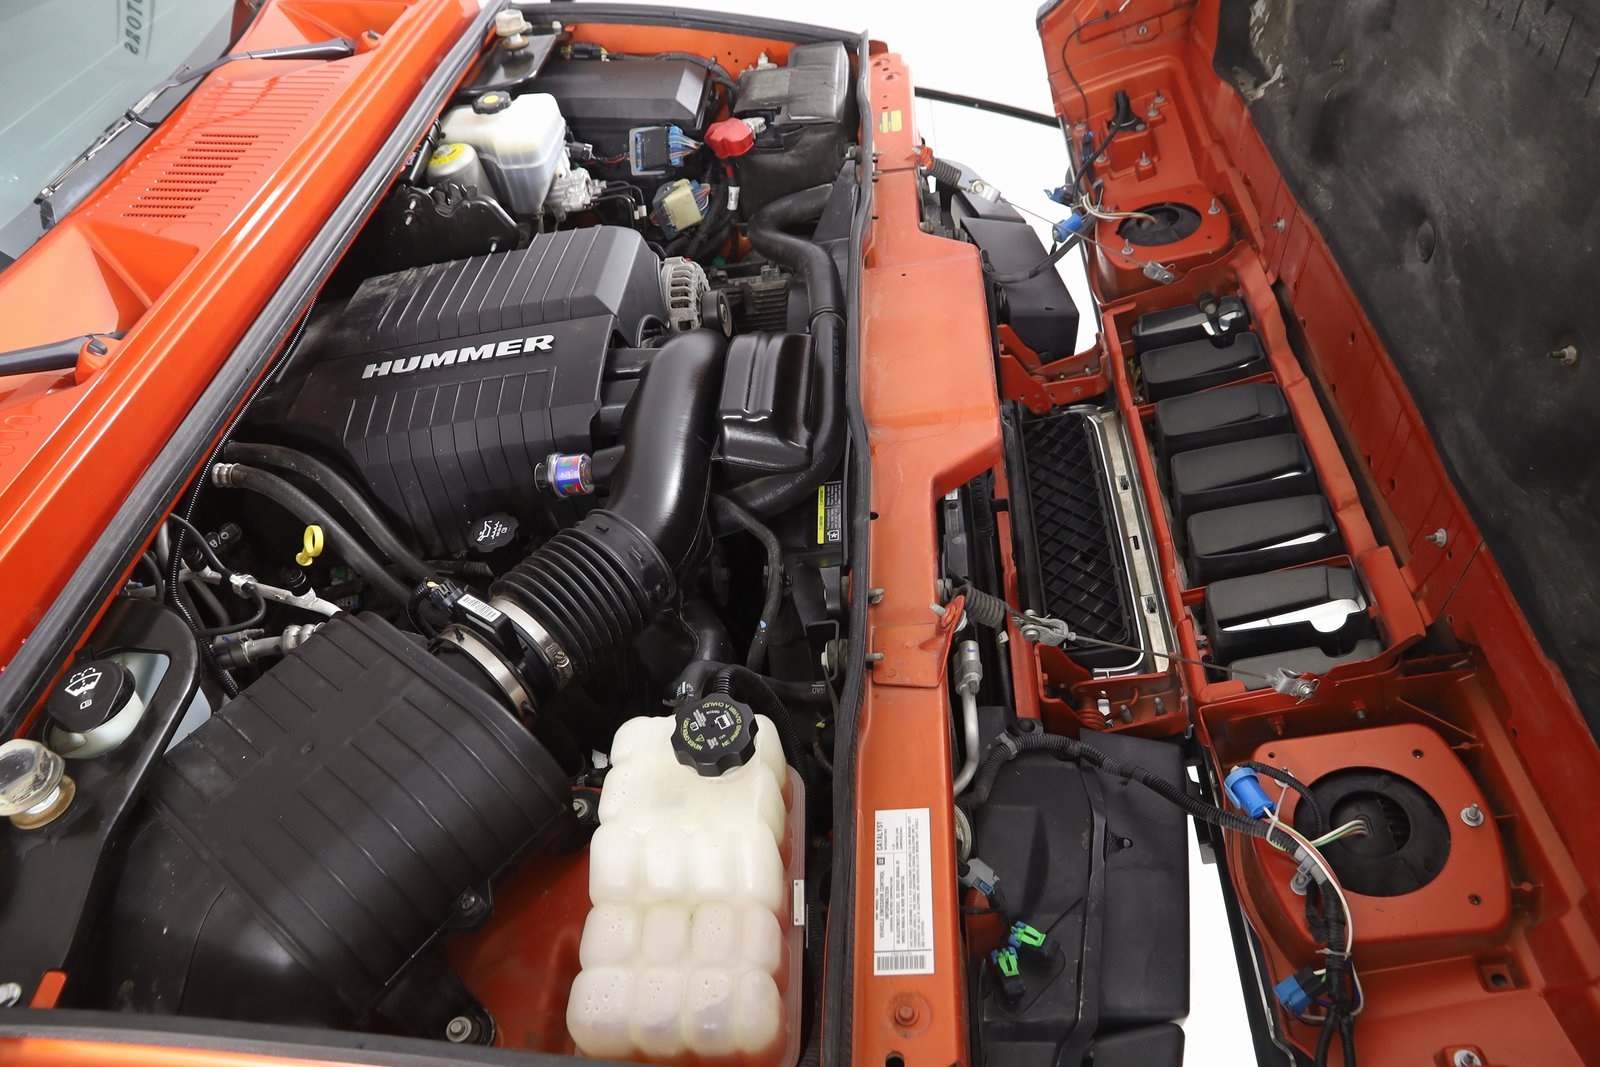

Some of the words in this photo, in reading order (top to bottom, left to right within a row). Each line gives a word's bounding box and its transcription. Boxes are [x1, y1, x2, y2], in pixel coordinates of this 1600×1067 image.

[362, 334, 555, 379] HUMMER
[687, 739, 703, 751] NEVER
[721, 739, 730, 747] NE
[876, 821, 884, 851] CATALYST
